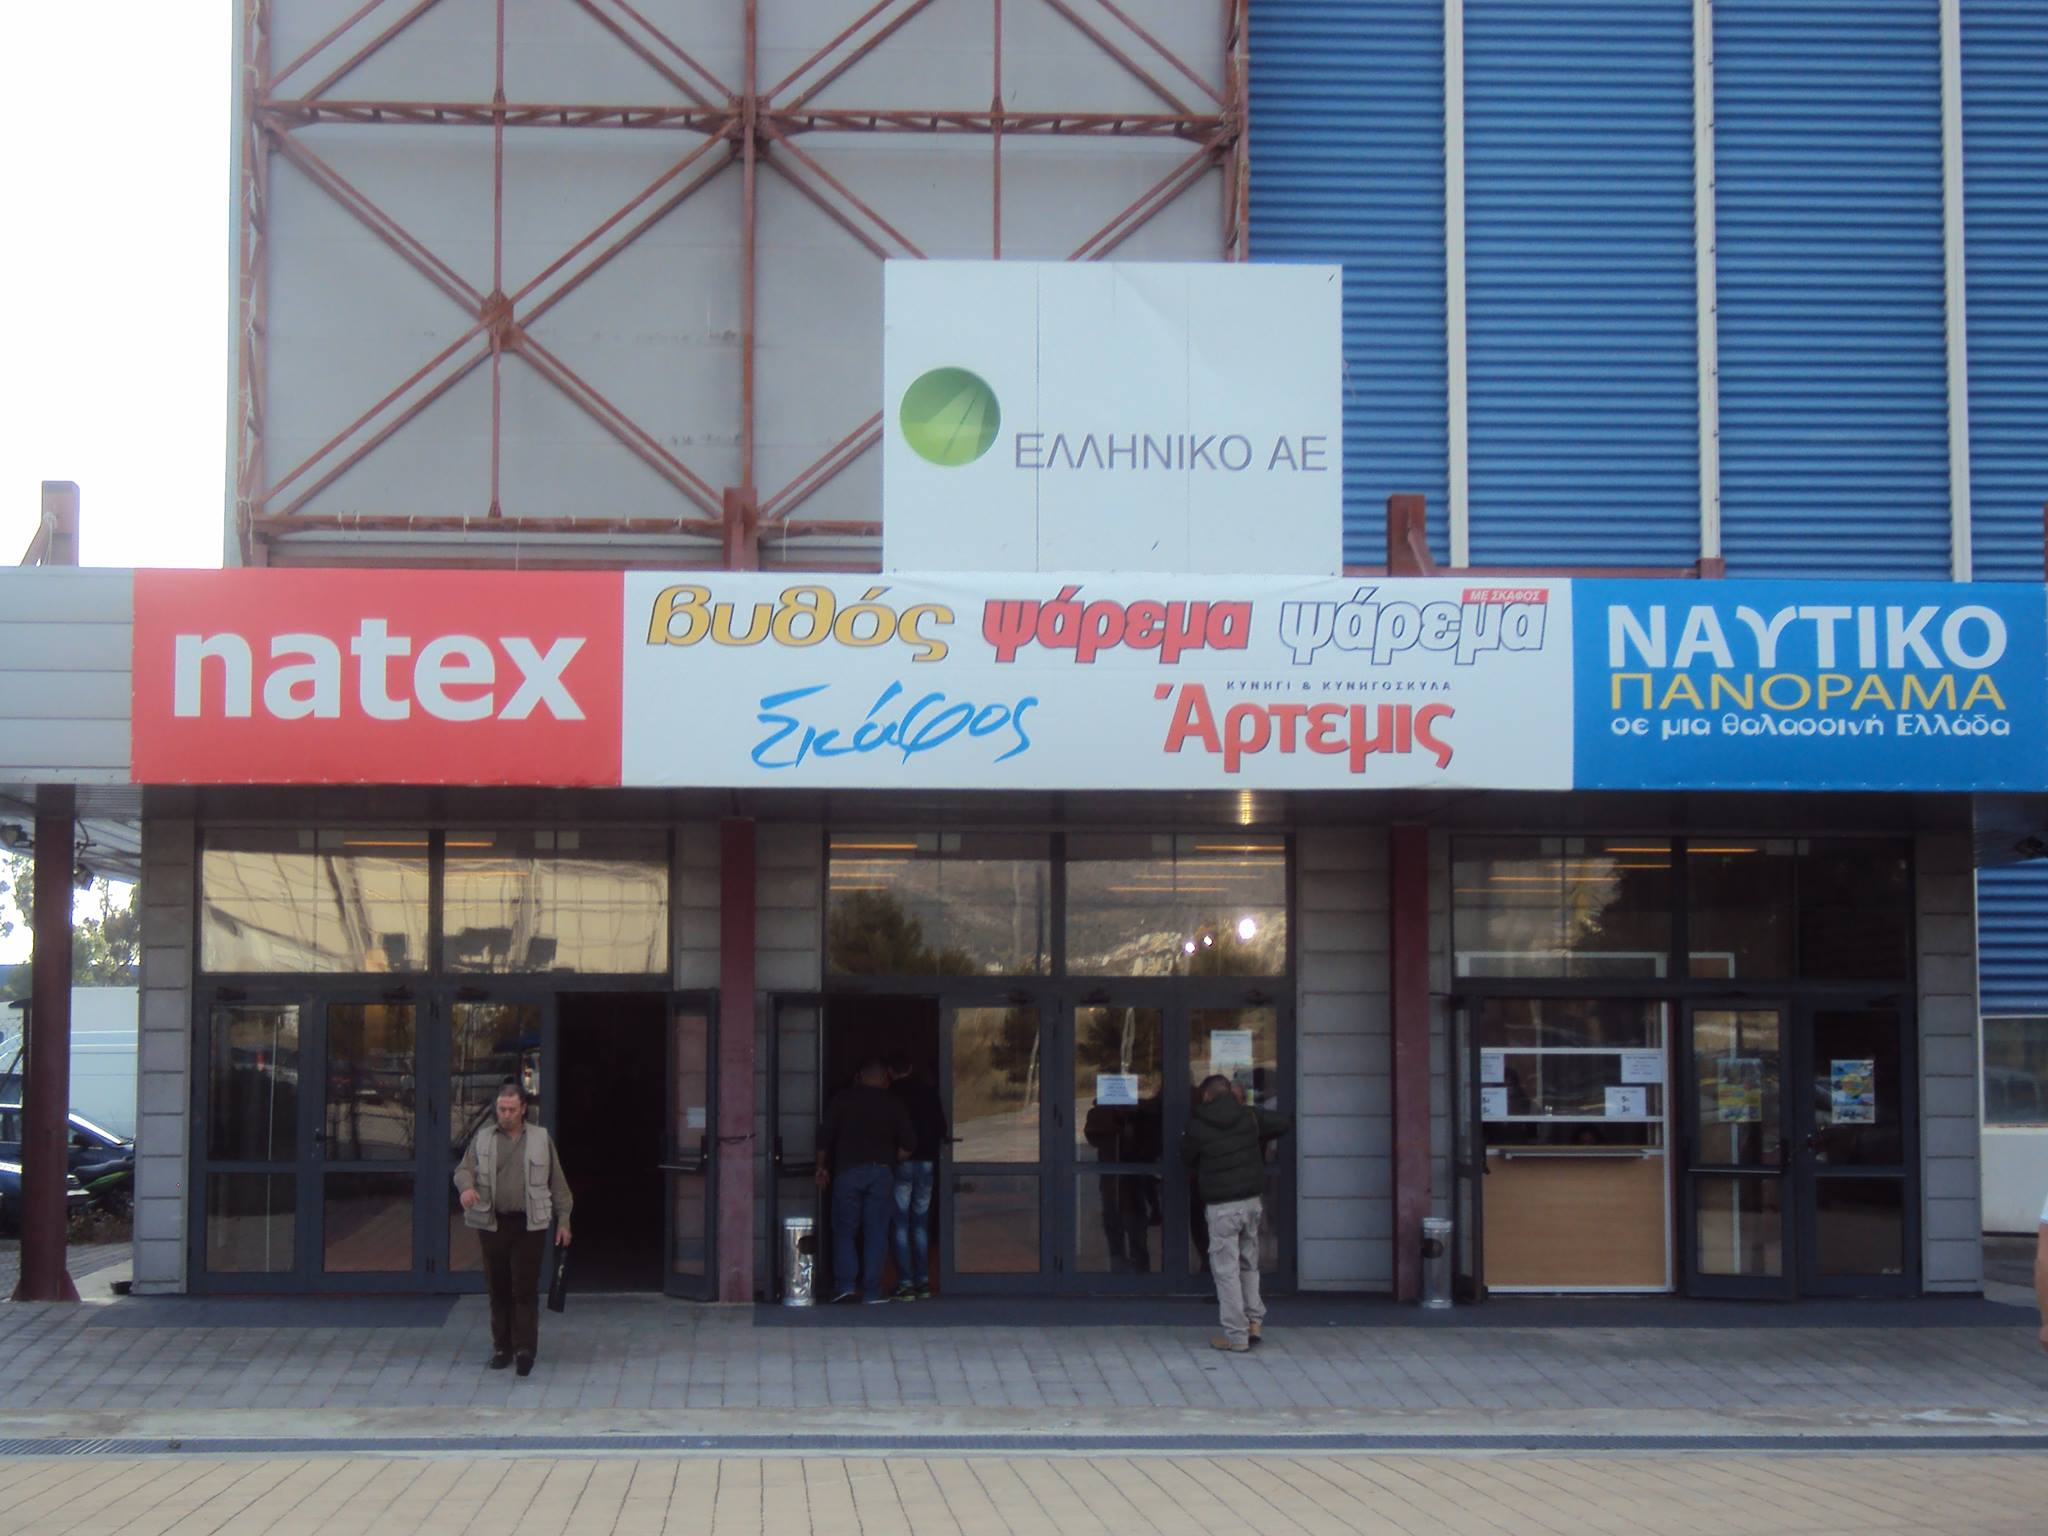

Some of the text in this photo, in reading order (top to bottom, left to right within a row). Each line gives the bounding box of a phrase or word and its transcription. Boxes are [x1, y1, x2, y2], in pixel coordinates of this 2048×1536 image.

[1015, 432, 1329, 472] ΕΛΛΗΝΙΚΟ ΑΕ
[646, 584, 956, 663] βυθός
[981, 585, 1255, 664] ψάρεμα
[1278, 586, 1549, 666] ψάρεμα
[1607, 604, 2008, 670] ΝΑΥΤΙΚΟ
[173, 617, 587, 722] natex
[1226, 680, 1291, 691] ΚΥΝΗΓΙ
[1302, 680, 1312, 691] &
[1610, 673, 2007, 711] ΠΑΝΟΡΑΜΑ
[750, 680, 1039, 769] Σκάφος
[1153, 682, 1456, 774] Άρτεμις
[1610, 712, 2010, 740] σε μια θαλασσινή Ελλάδα
